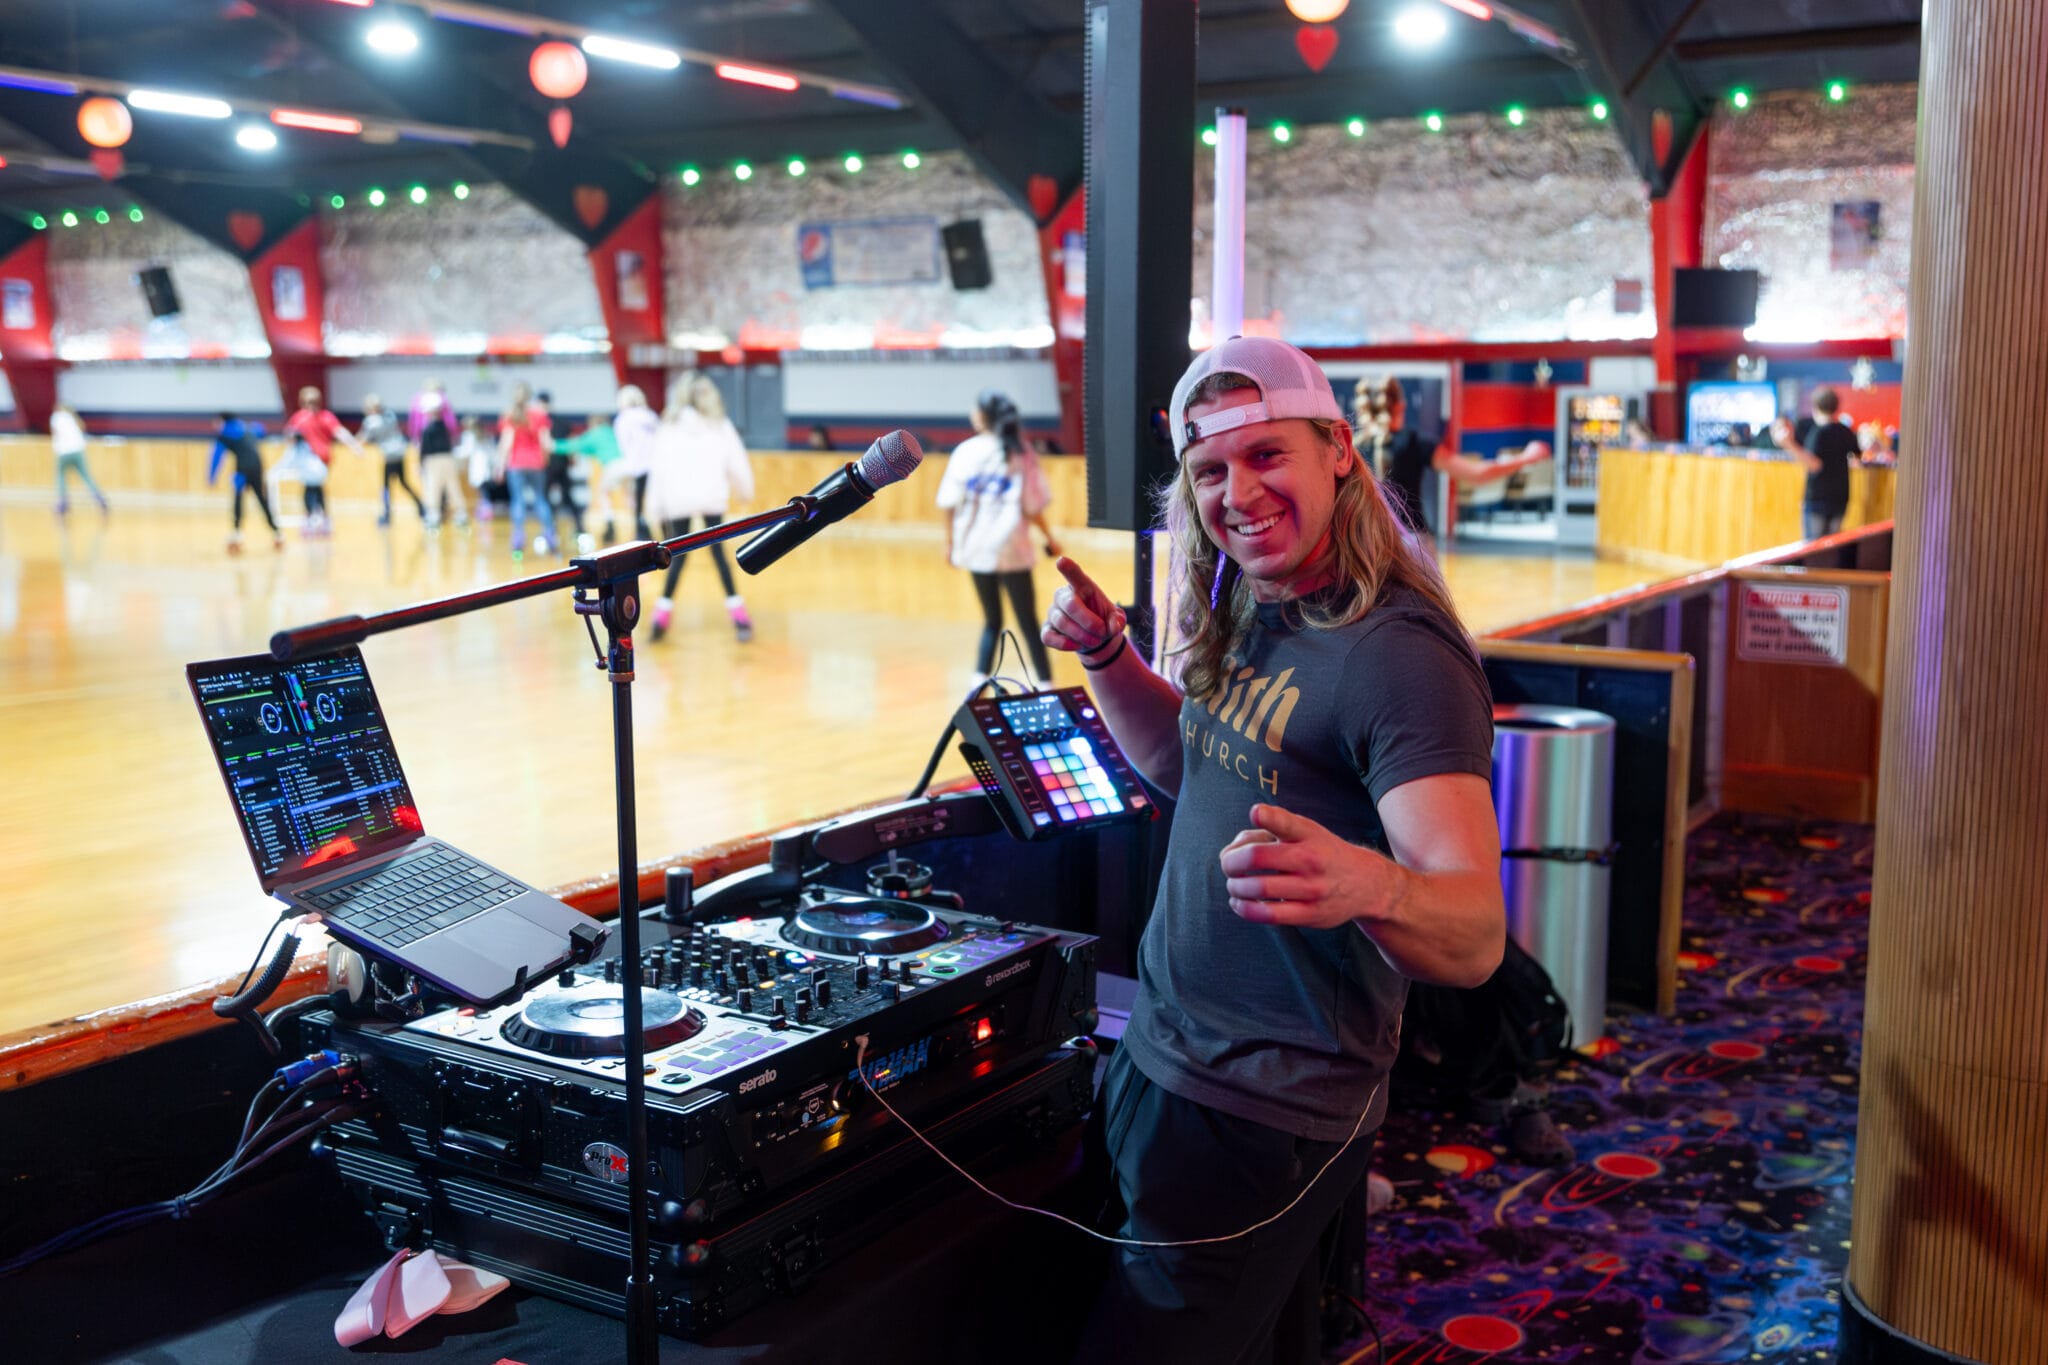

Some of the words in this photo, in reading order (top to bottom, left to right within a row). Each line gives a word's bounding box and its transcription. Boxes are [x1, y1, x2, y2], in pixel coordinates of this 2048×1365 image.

[1185, 719, 1279, 796] HURCH
[738, 1068, 777, 1096] serato
[591, 1151, 627, 1174] ProX
